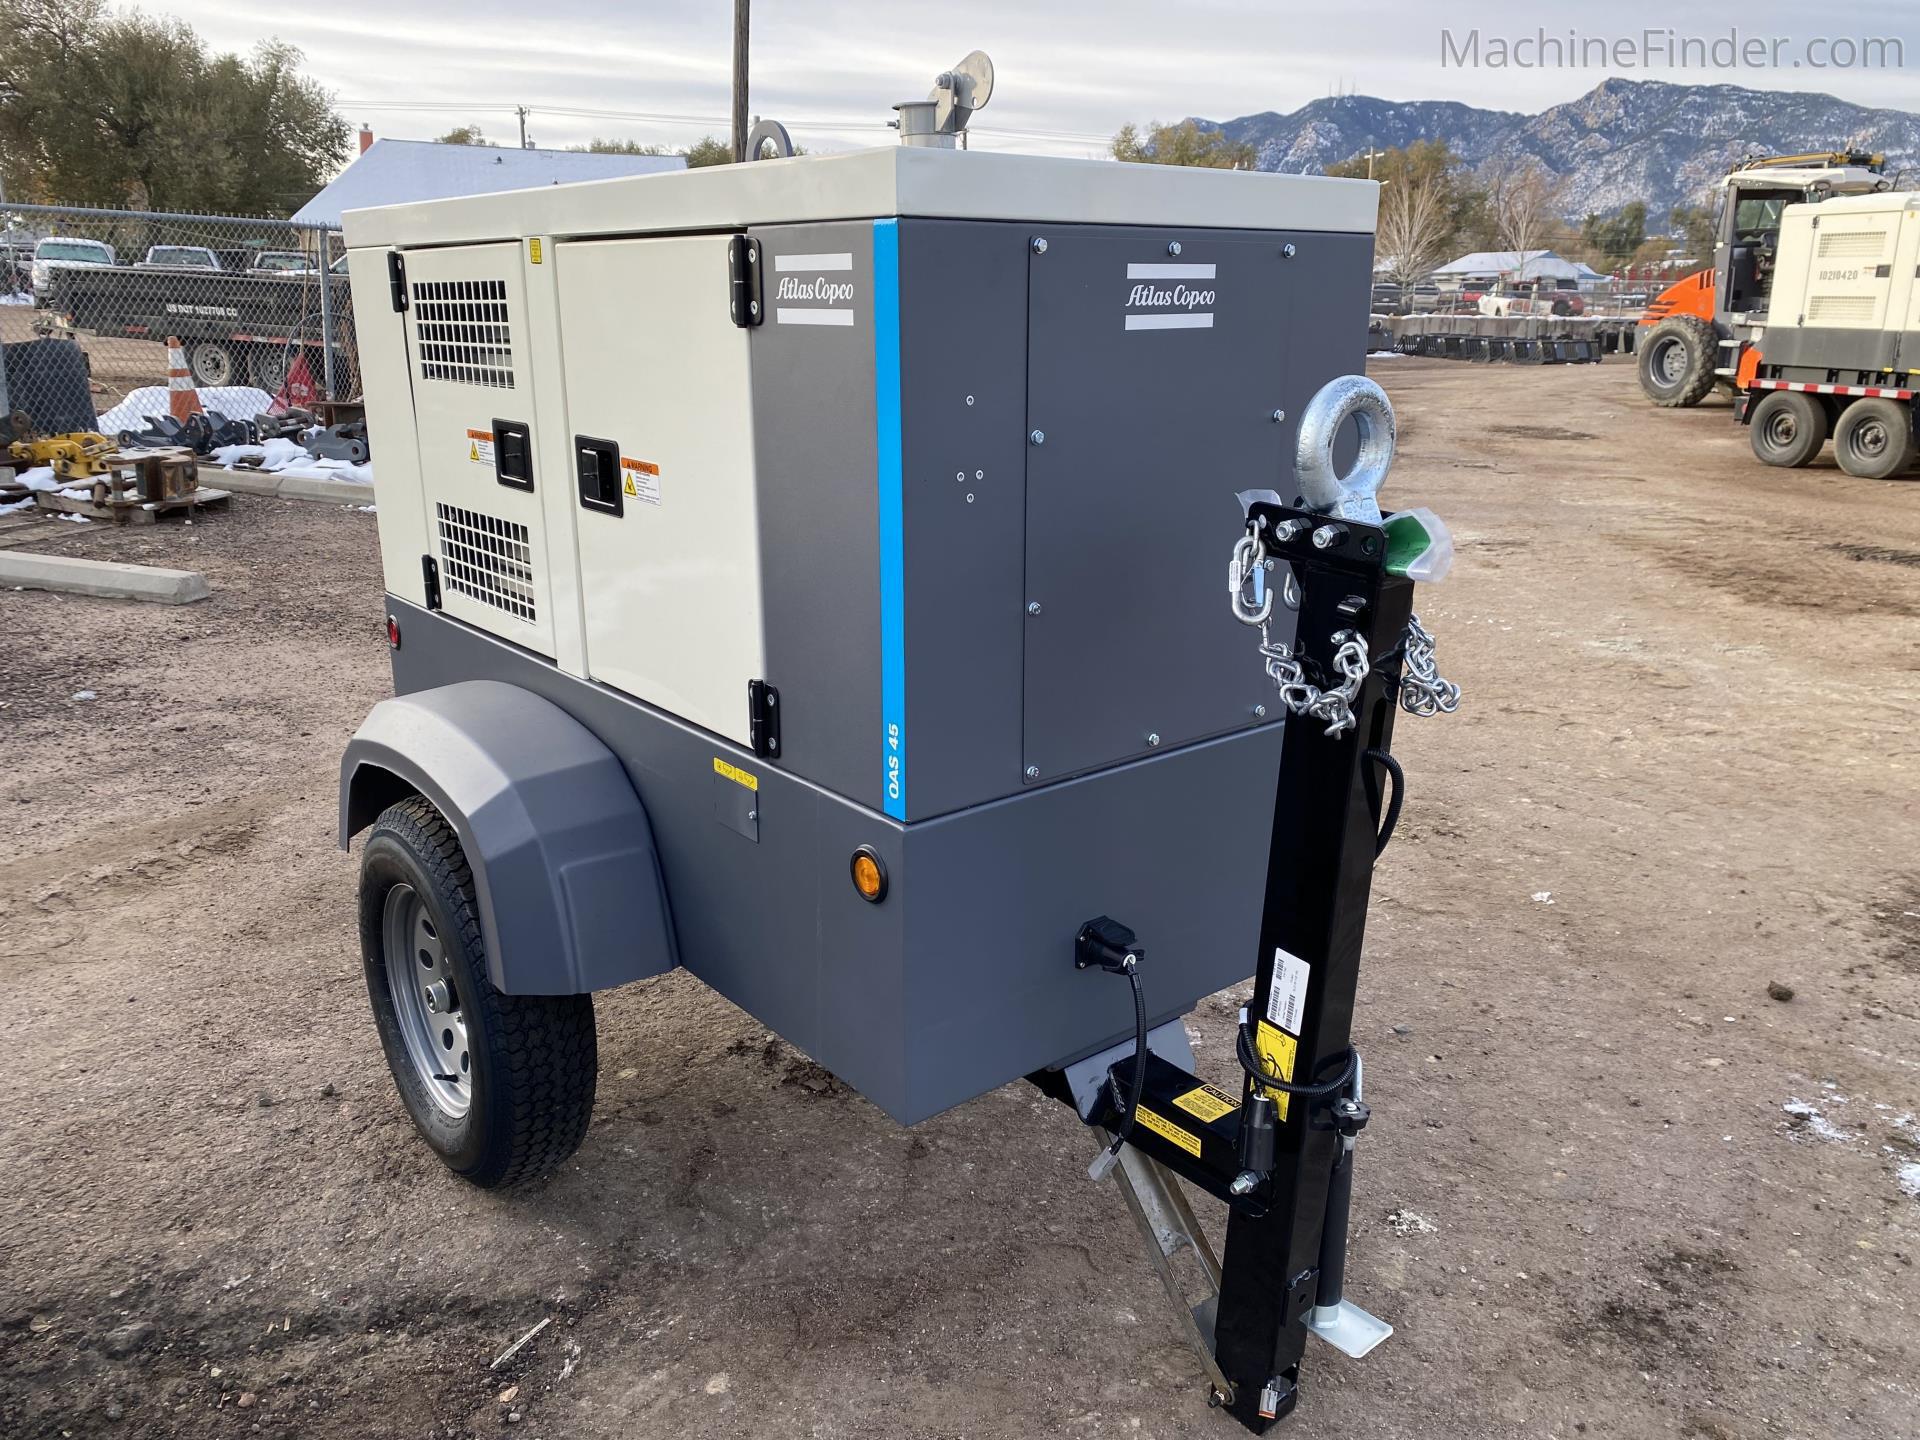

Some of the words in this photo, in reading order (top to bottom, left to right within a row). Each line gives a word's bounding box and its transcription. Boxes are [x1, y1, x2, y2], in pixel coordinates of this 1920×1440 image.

[1819, 270, 1858, 281] 10210420
[775, 277, 813, 300] Atlas
[814, 277, 853, 304] Copco
[1125, 284, 1172, 307] Atlas
[1173, 284, 1215, 310] Copco
[166, 303, 178, 313] US
[178, 304, 193, 314] DOT
[888, 722, 899, 751] 45
[1203, 1086, 1241, 1109] CAUTION
